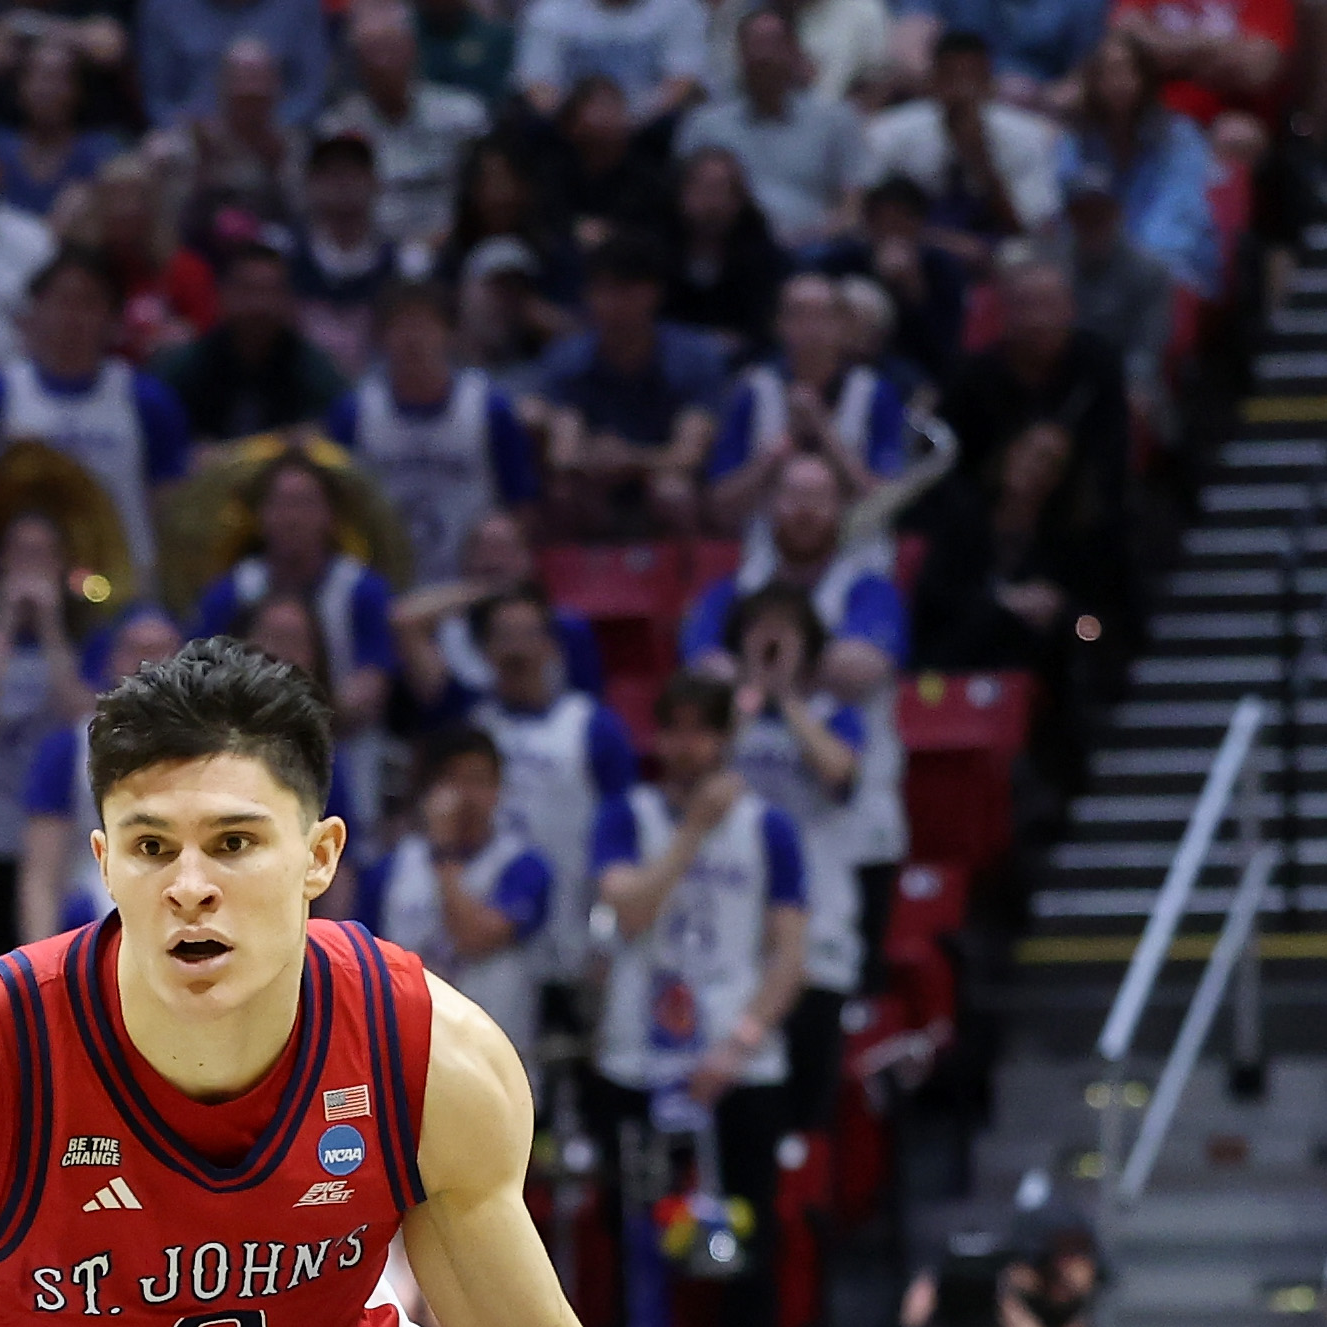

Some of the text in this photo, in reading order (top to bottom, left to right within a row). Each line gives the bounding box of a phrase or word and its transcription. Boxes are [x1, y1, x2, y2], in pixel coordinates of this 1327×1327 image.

[68, 1137, 120, 1152] BE THE
[61, 1151, 121, 1167] CHANGE
[324, 1147, 363, 1164] NCAA
[306, 1180, 348, 1193] BIG
[298, 1189, 356, 1203] EAST
[32, 1223, 370, 1316] ST. JOHN'S
